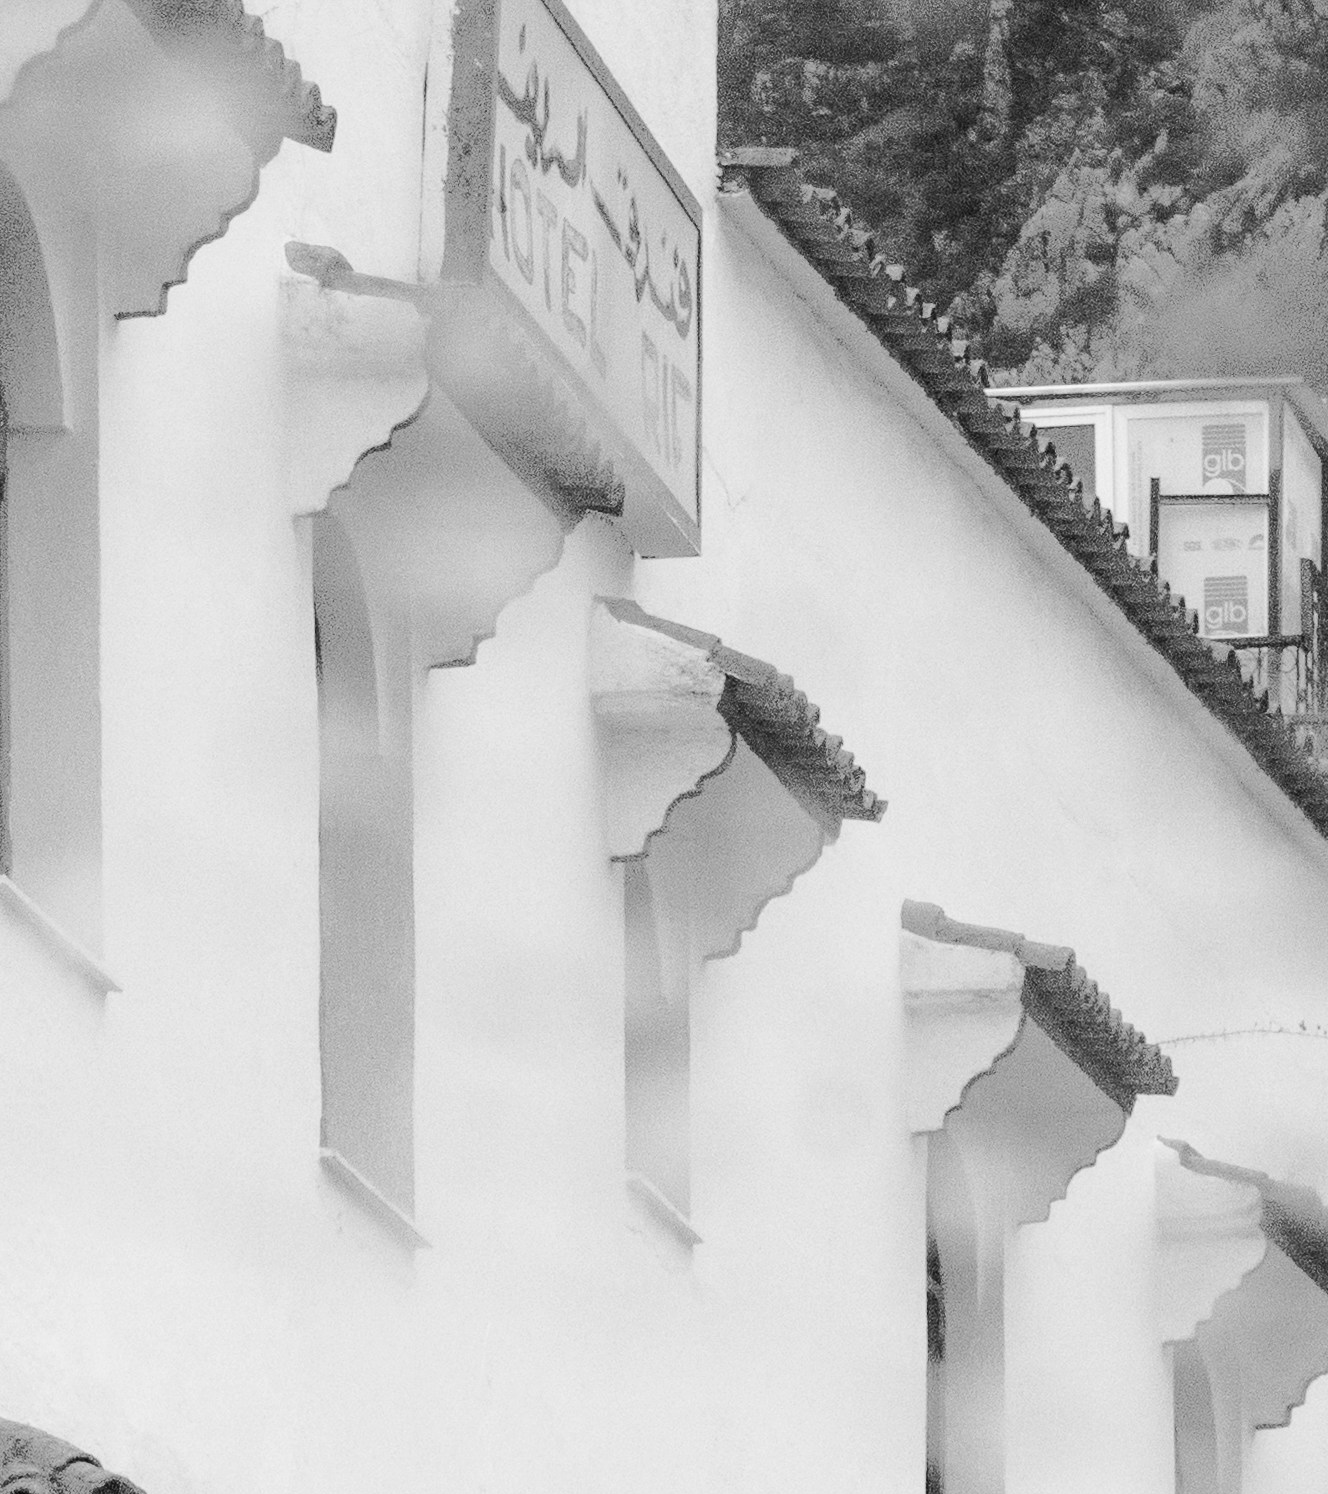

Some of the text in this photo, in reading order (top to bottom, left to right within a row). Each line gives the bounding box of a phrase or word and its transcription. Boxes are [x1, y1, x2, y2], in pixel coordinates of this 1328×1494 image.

[590, 167, 692, 339] فندق
[641, 329, 692, 470] RIF
[1204, 449, 1245, 477] glb
[1205, 600, 1247, 628] glb
